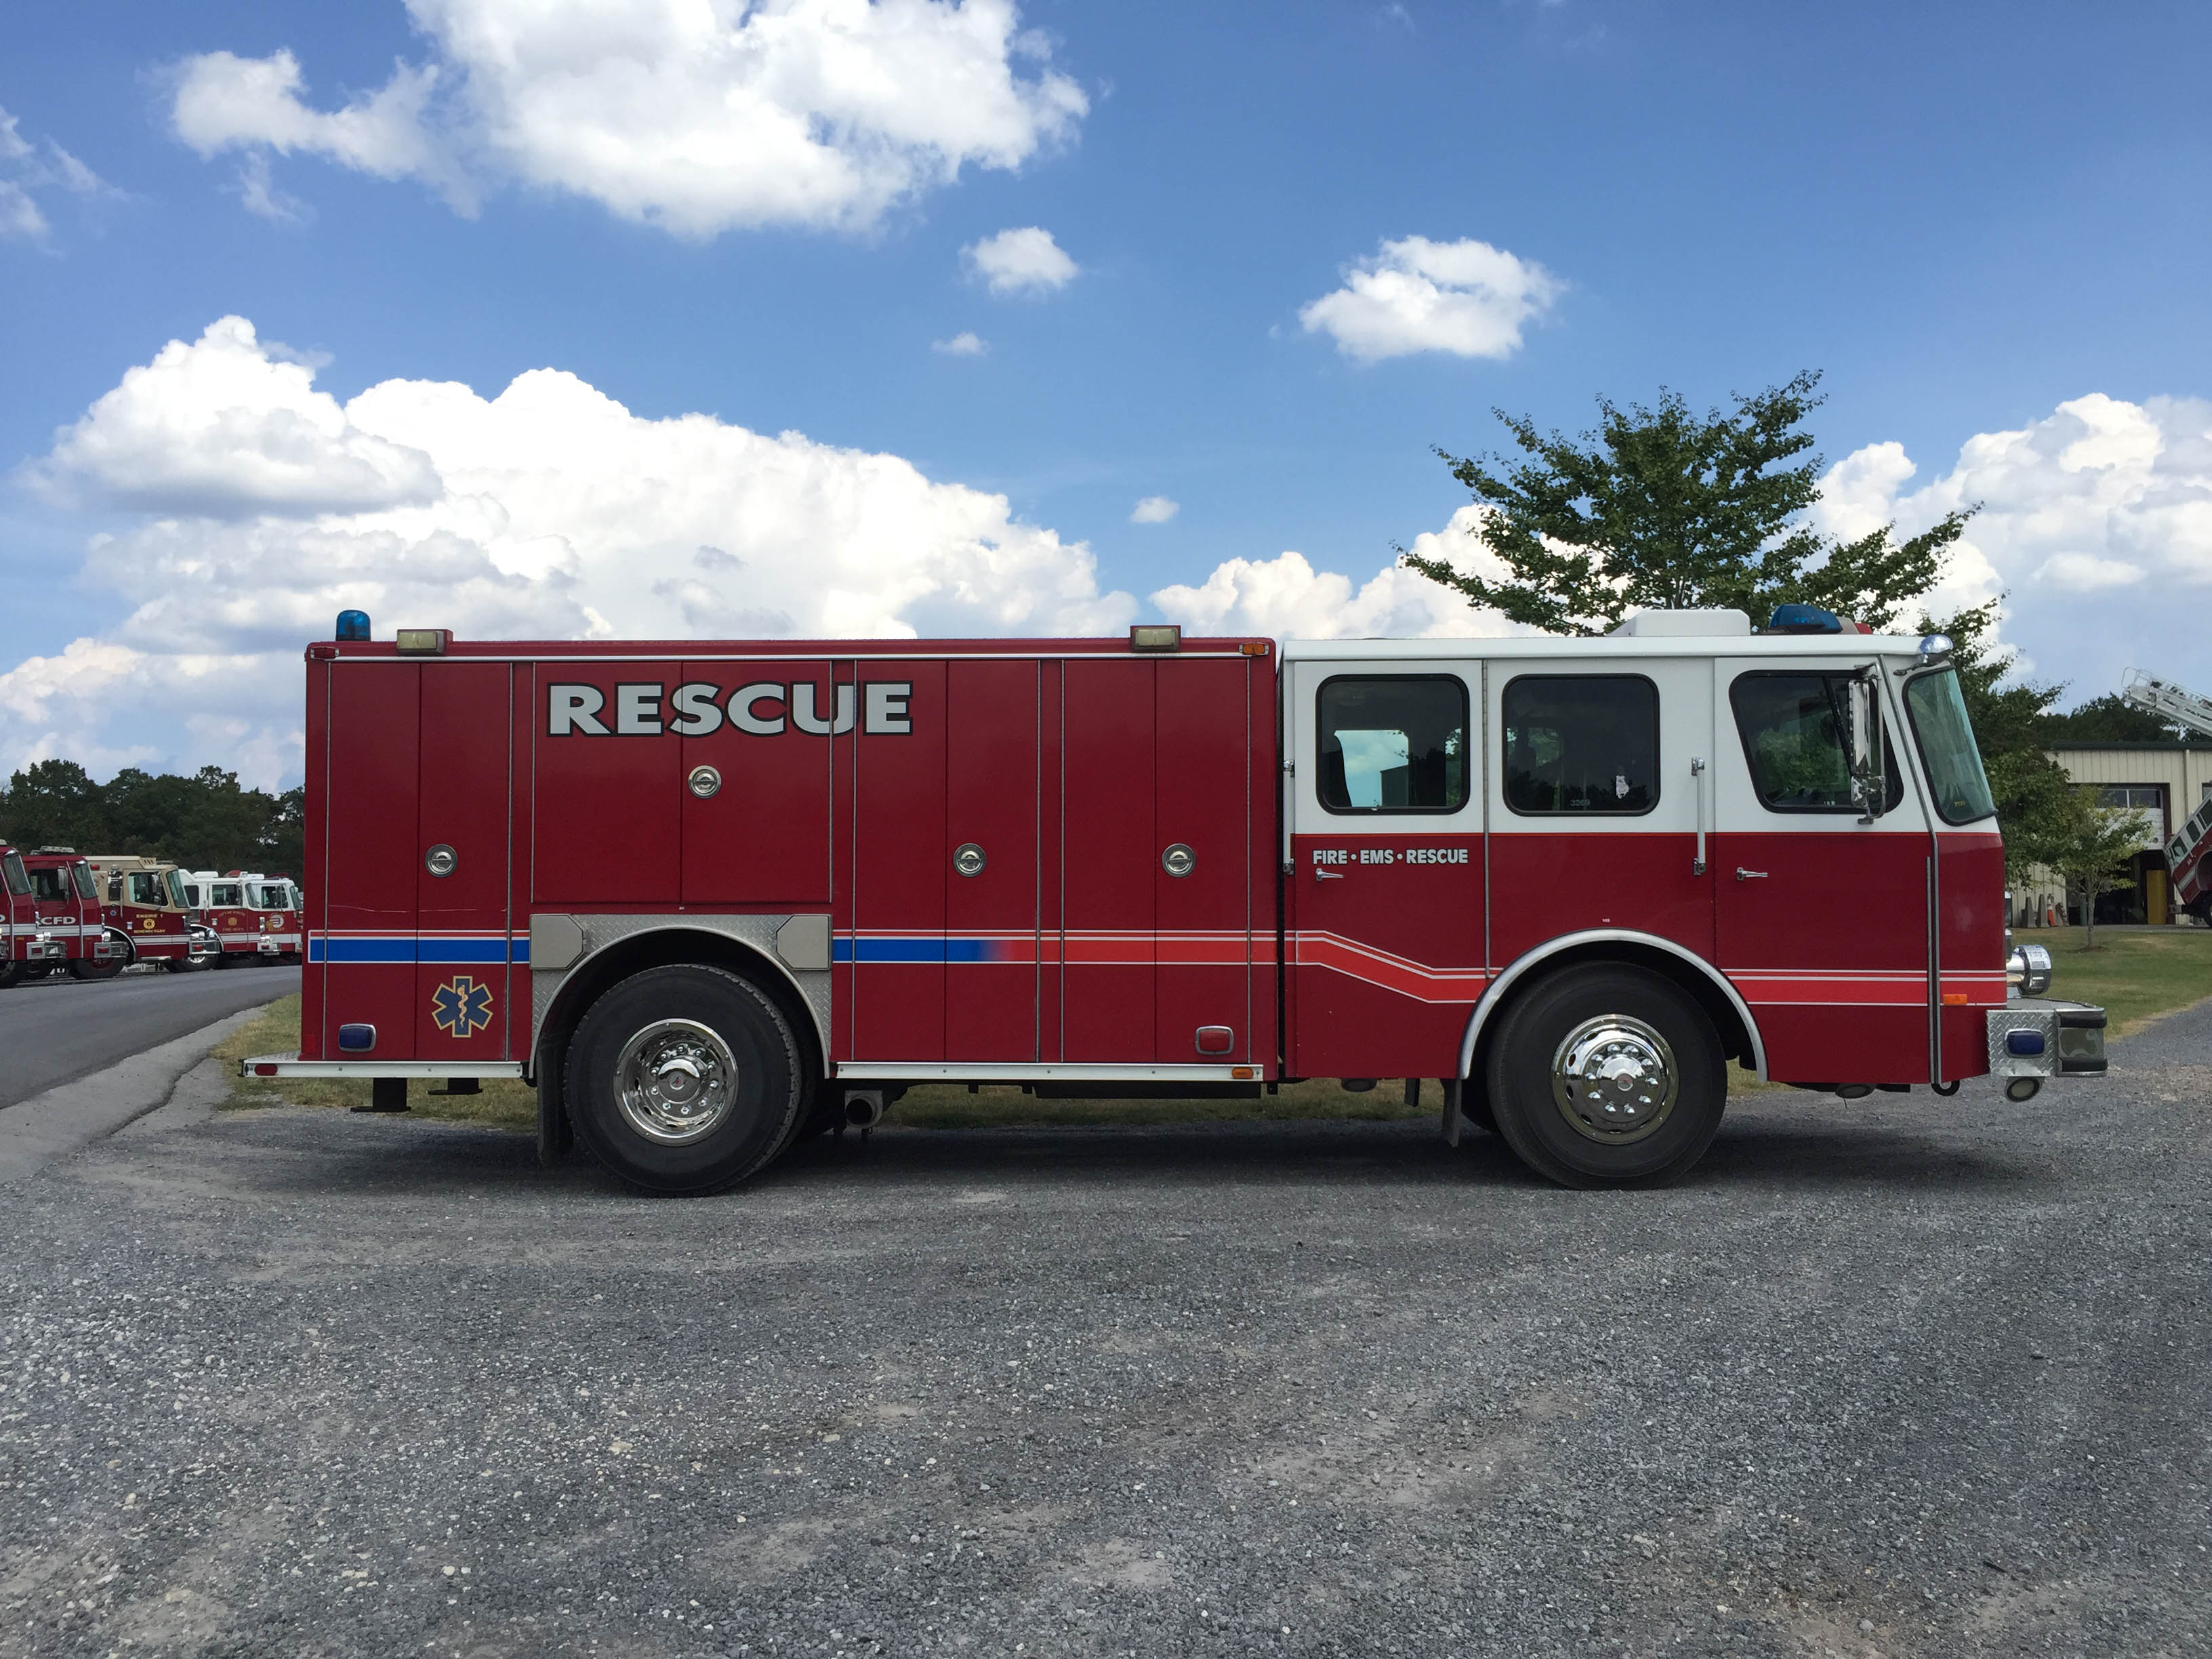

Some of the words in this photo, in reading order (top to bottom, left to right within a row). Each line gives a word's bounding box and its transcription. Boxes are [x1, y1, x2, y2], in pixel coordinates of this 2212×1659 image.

[547, 681, 914, 737] RESCUE
[1313, 850, 1347, 865] FIRE
[1360, 849, 1394, 864] EMS
[1406, 848, 1469, 864] RESCUE
